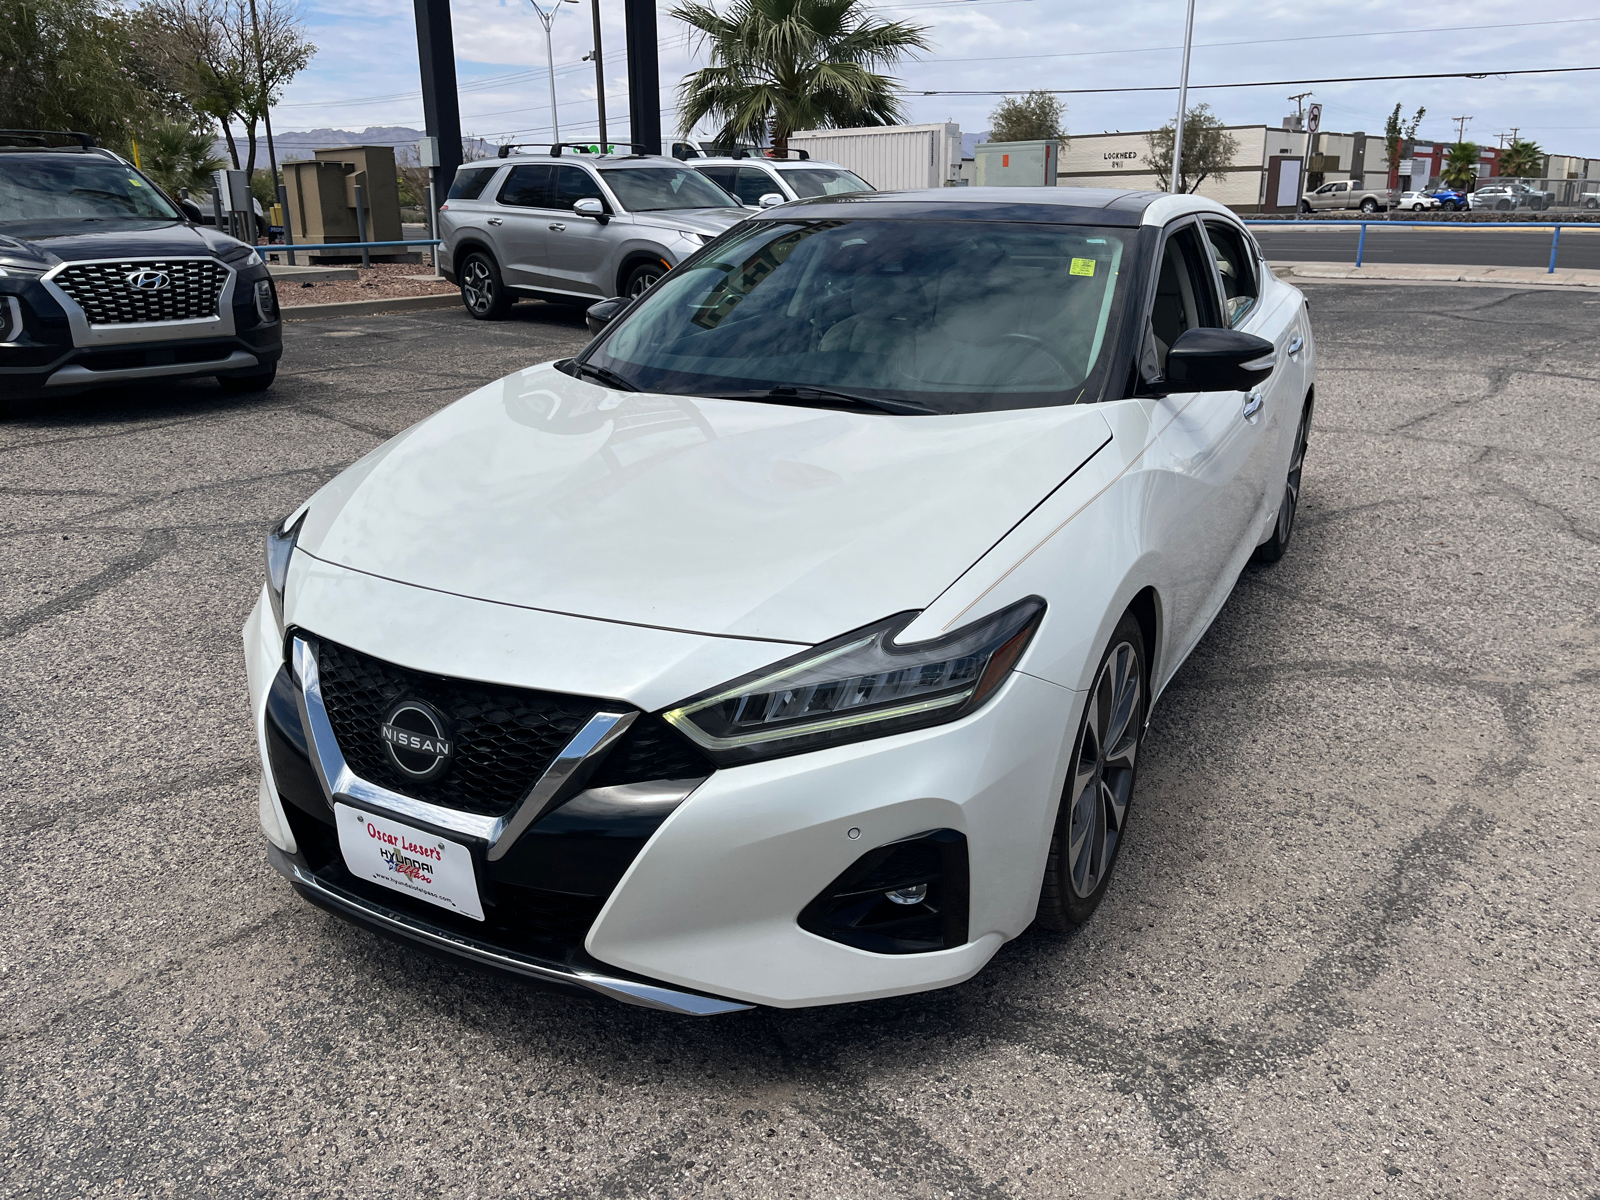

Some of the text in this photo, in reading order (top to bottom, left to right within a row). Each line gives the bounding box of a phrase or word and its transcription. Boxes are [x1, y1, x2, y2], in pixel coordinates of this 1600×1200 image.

[1103, 151, 1137, 160] LOCKHEED
[382, 726, 449, 755] NISSAN
[367, 823, 441, 861] Oscar Leeser's
[380, 848, 434, 874] HYUNDAI
[397, 863, 412, 874] El
[409, 866, 432, 884] Paso
